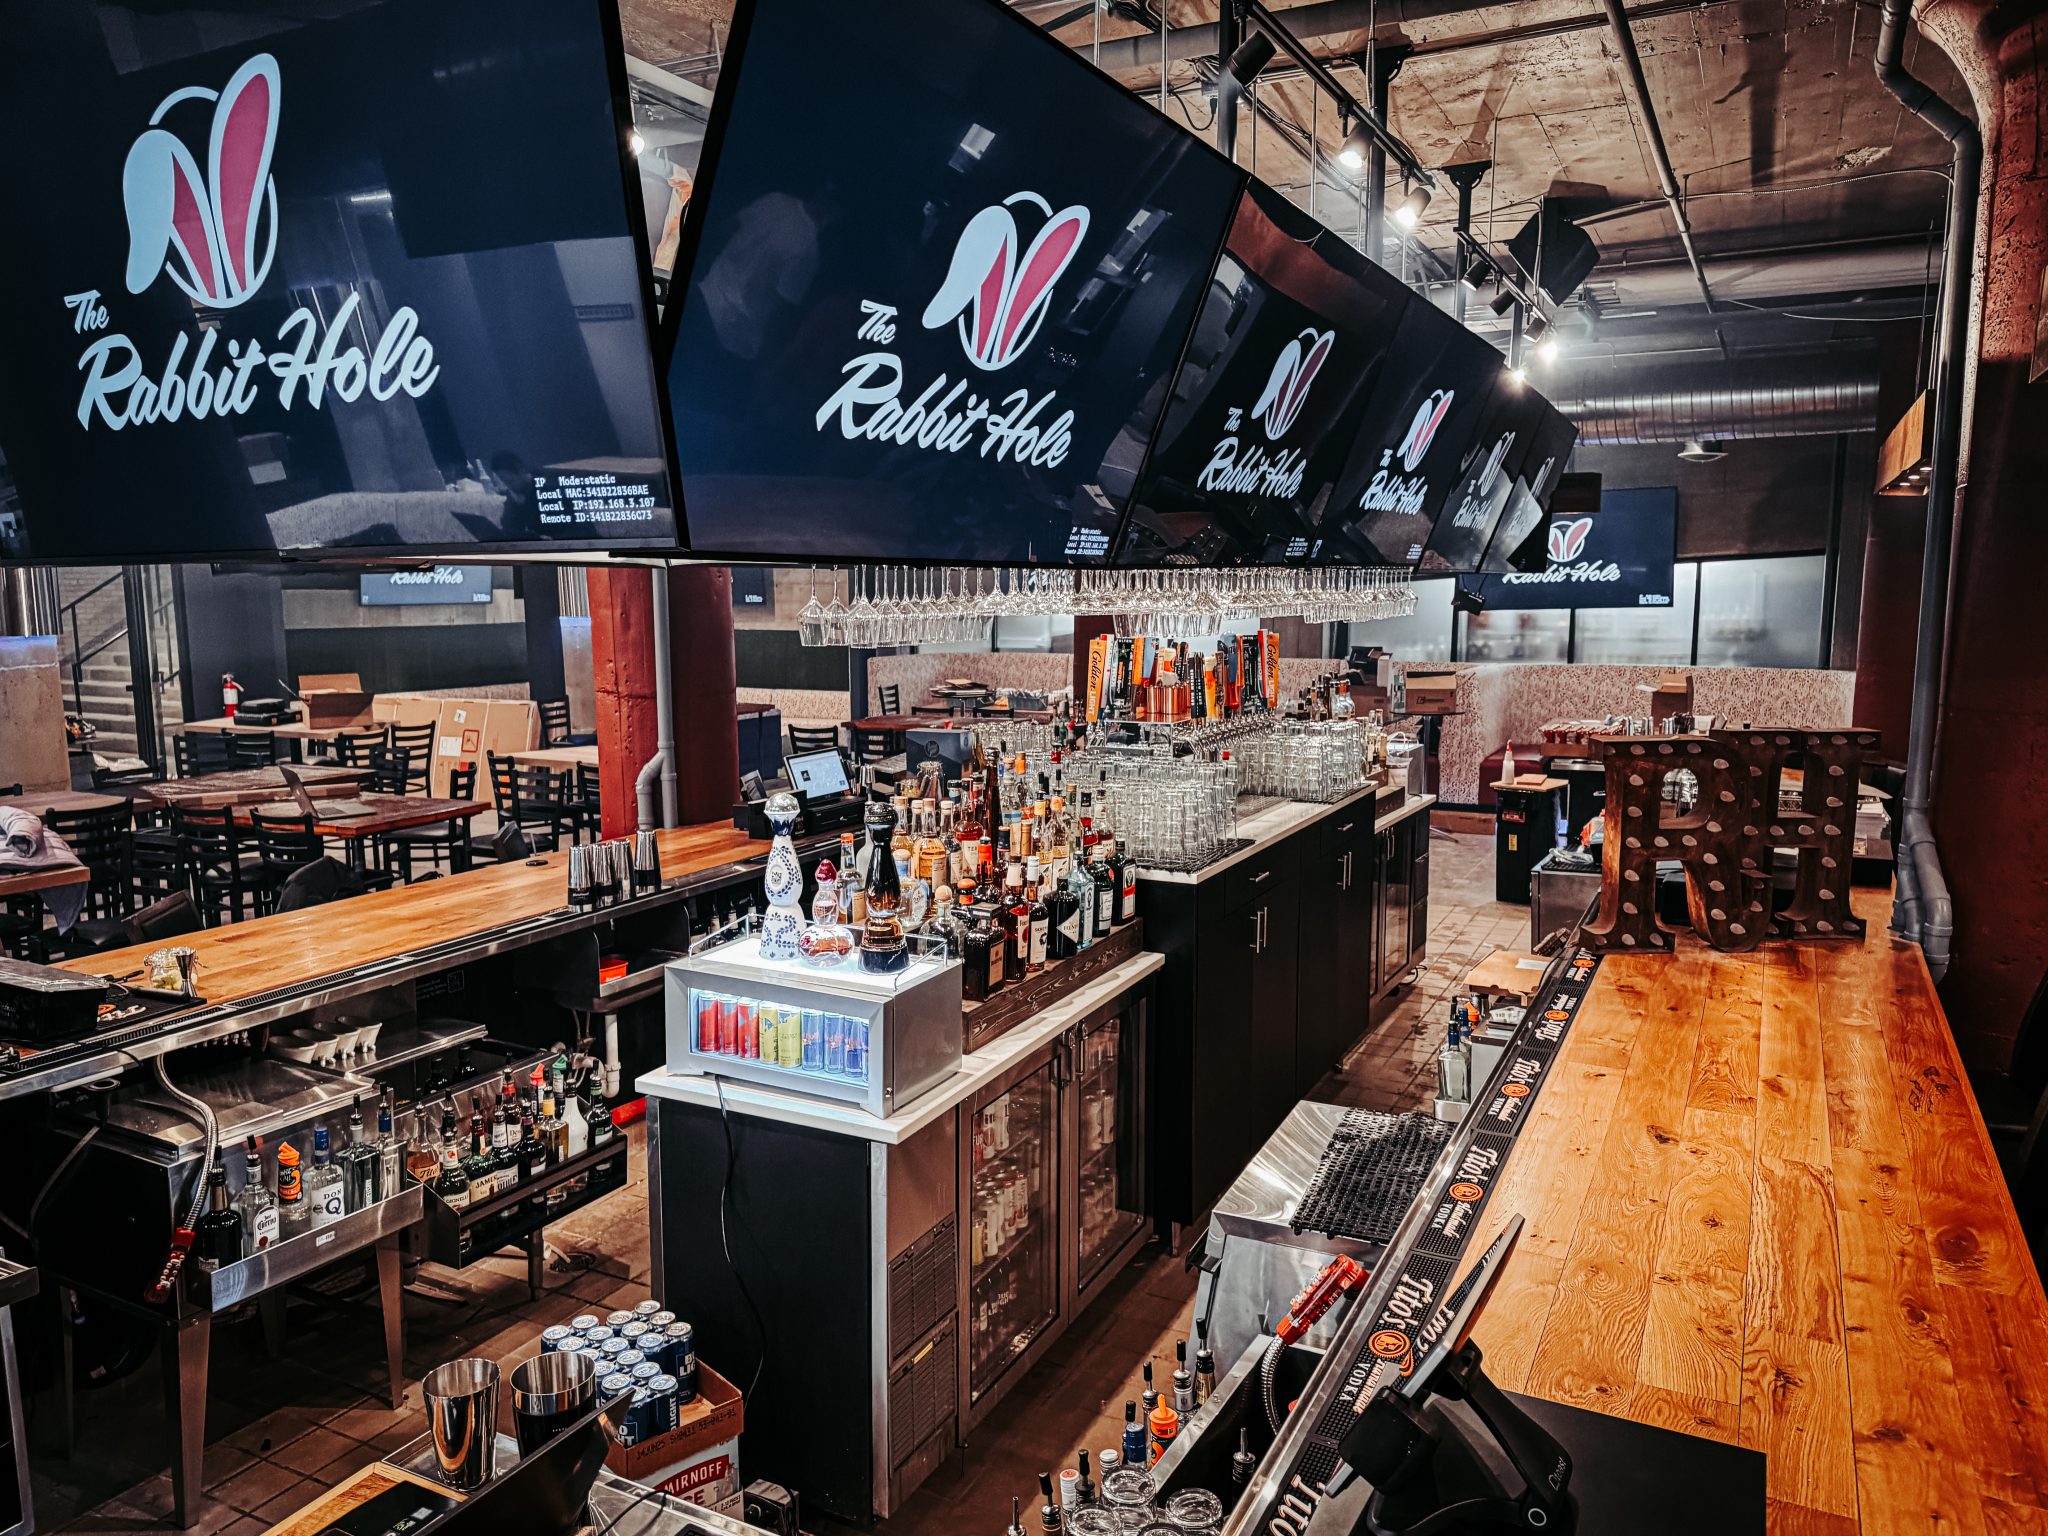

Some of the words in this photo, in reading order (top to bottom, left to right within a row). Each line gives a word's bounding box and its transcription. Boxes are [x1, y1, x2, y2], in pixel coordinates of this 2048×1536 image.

[64, 290, 110, 334] The
[858, 299, 898, 345] The
[77, 327, 264, 431] Rabbit
[268, 291, 440, 411] Hole
[816, 352, 989, 454] Rabbit
[980, 388, 1075, 469] Hole
[1223, 405, 1242, 432] The
[1198, 436, 1269, 493] Rabbit
[1259, 447, 1307, 500] Hole
[534, 477, 546, 488] IP
[536, 490, 562, 500] Local
[1359, 470, 1405, 511] Rabbit
[1396, 476, 1428, 515] Hole
[538, 502, 564, 512] Local
[540, 514, 571, 524] Remote
[434, 567, 464, 584] Hole
[1570, 560, 1621, 582] Hole
[1506, 1057, 1540, 1085] Tito's
[1456, 1145, 1498, 1184] Tito's
[324, 1188, 342, 1200] DON
[325, 1197, 342, 1215] Q
[1431, 1204, 1453, 1229] VODKA
[1382, 1273, 1434, 1330] Tito's
[1339, 1362, 1371, 1401] VODKA
[664, 1461, 723, 1496] MIRNOFF
